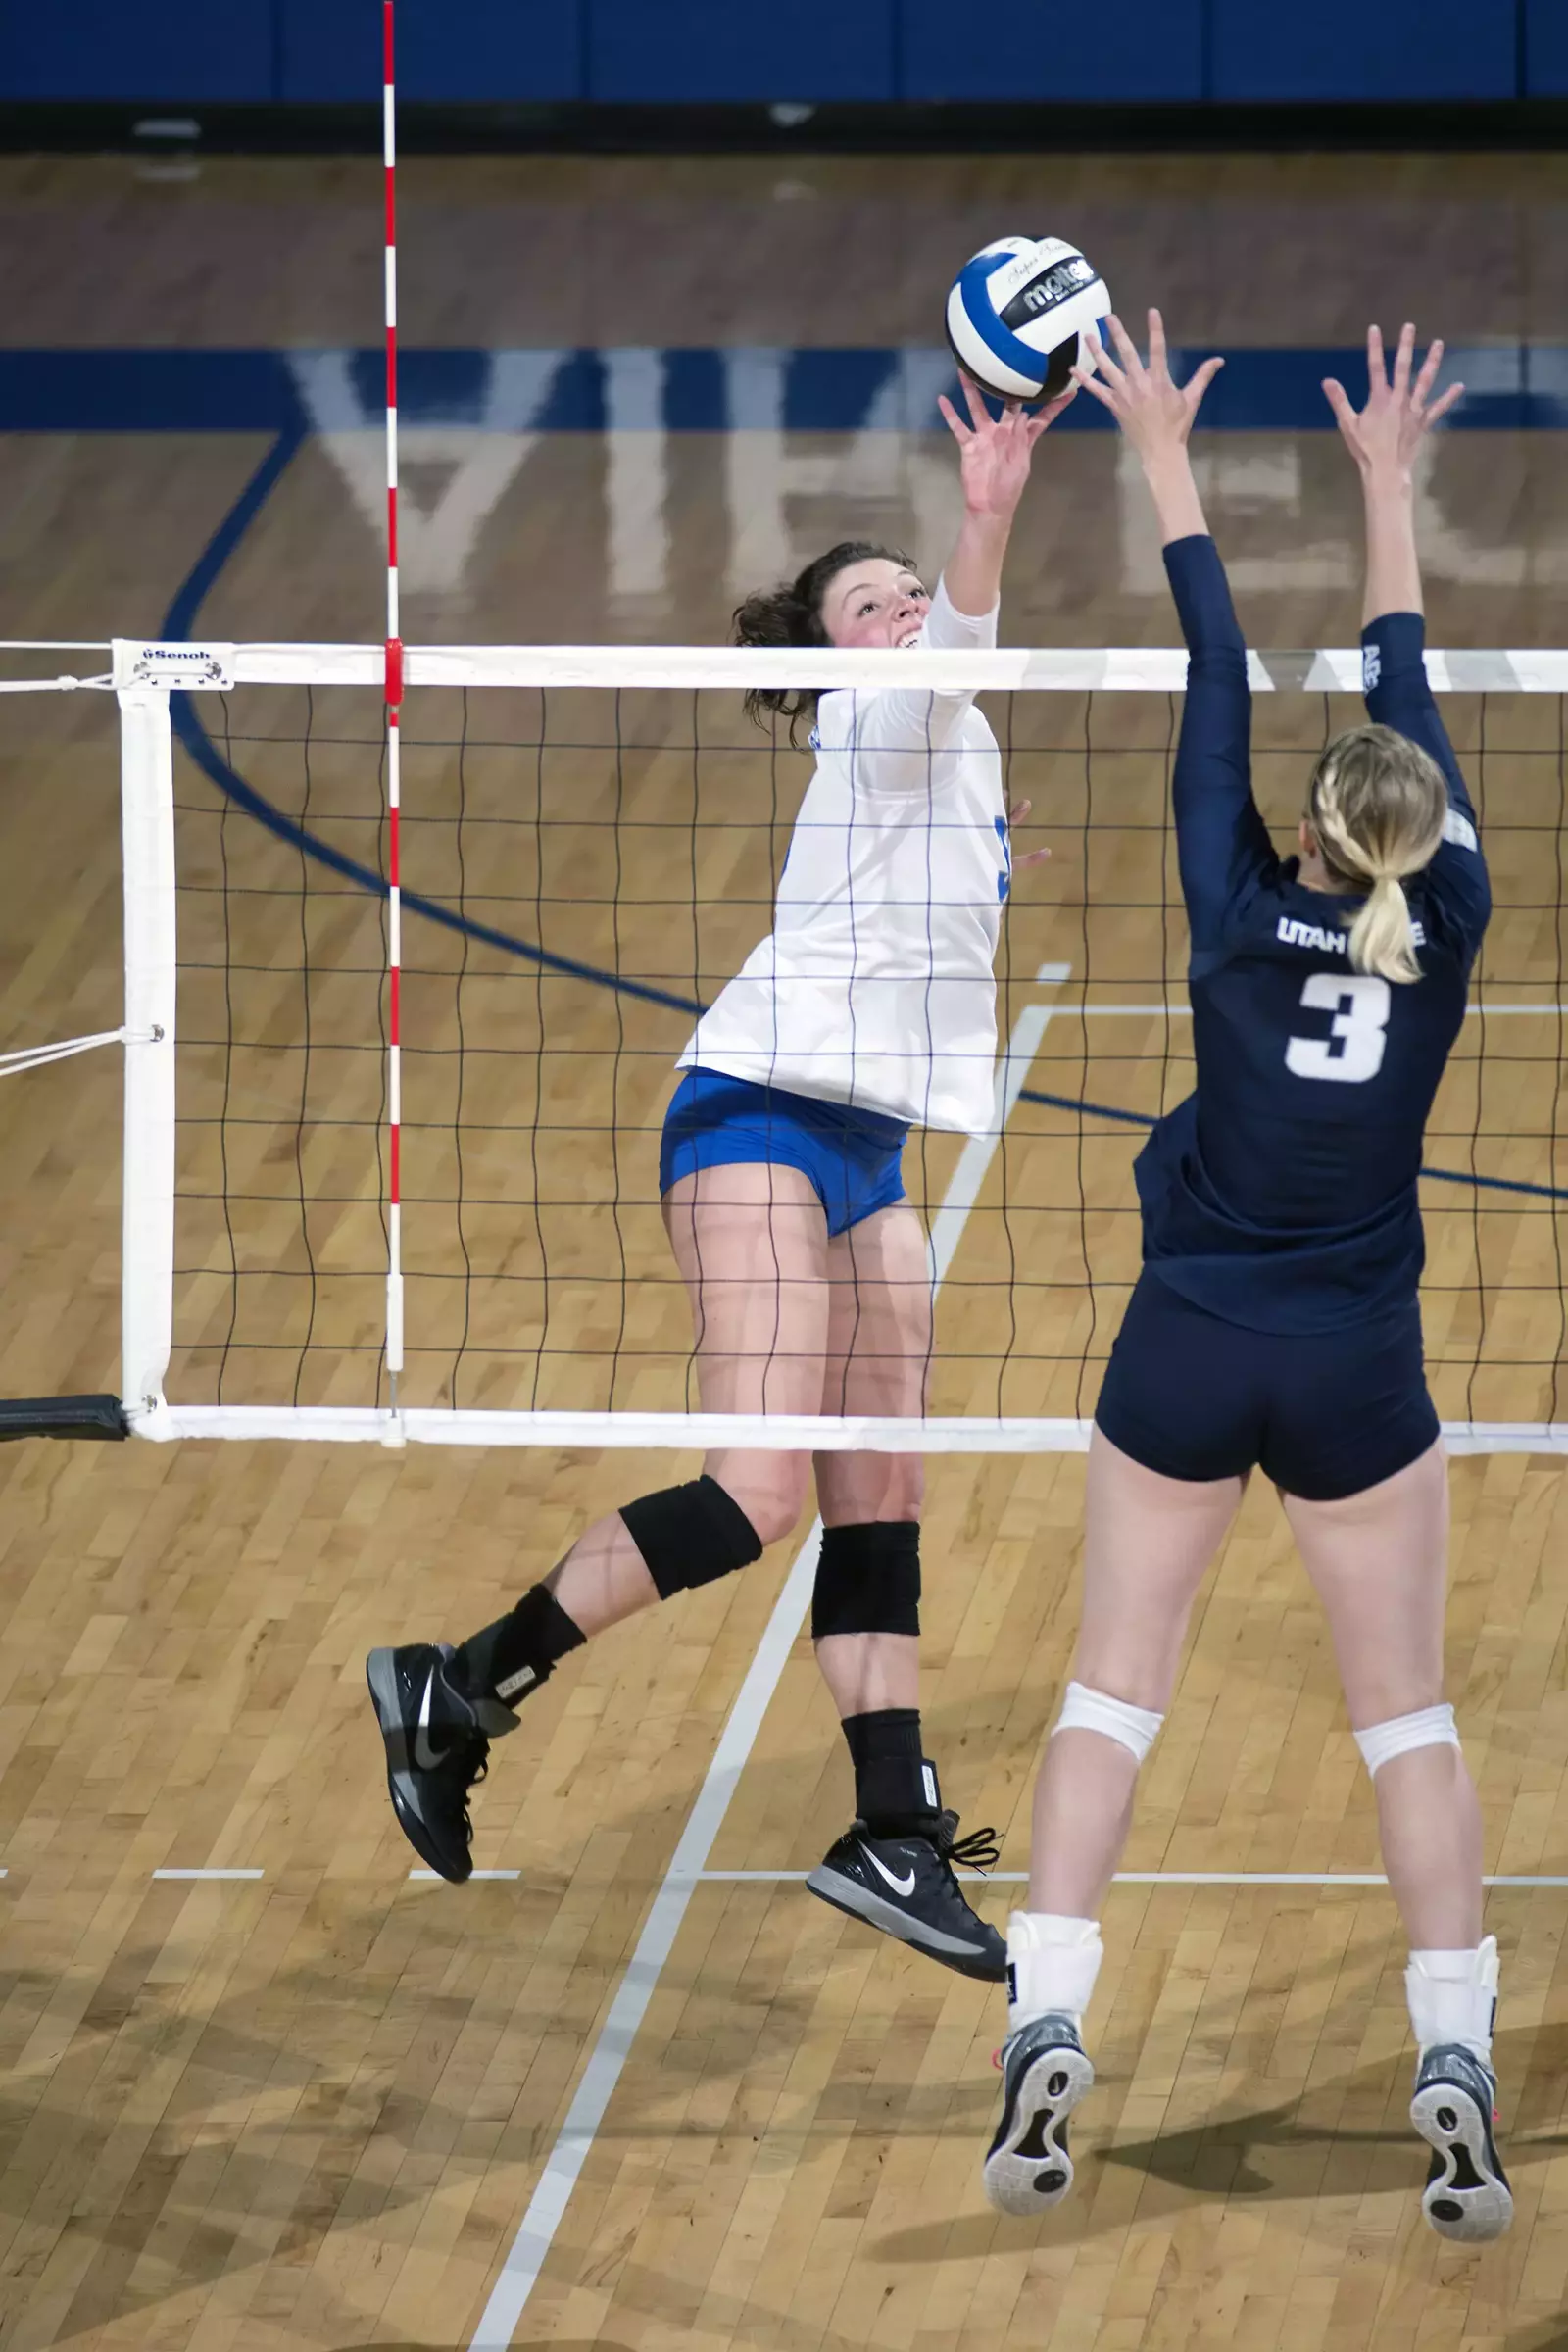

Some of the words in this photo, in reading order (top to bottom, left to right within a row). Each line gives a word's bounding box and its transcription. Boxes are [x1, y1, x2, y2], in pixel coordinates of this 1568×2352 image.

[155, 650, 211, 659] Senoh
[1277, 916, 1347, 954] UTAH
[1285, 973, 1392, 1083] 3
